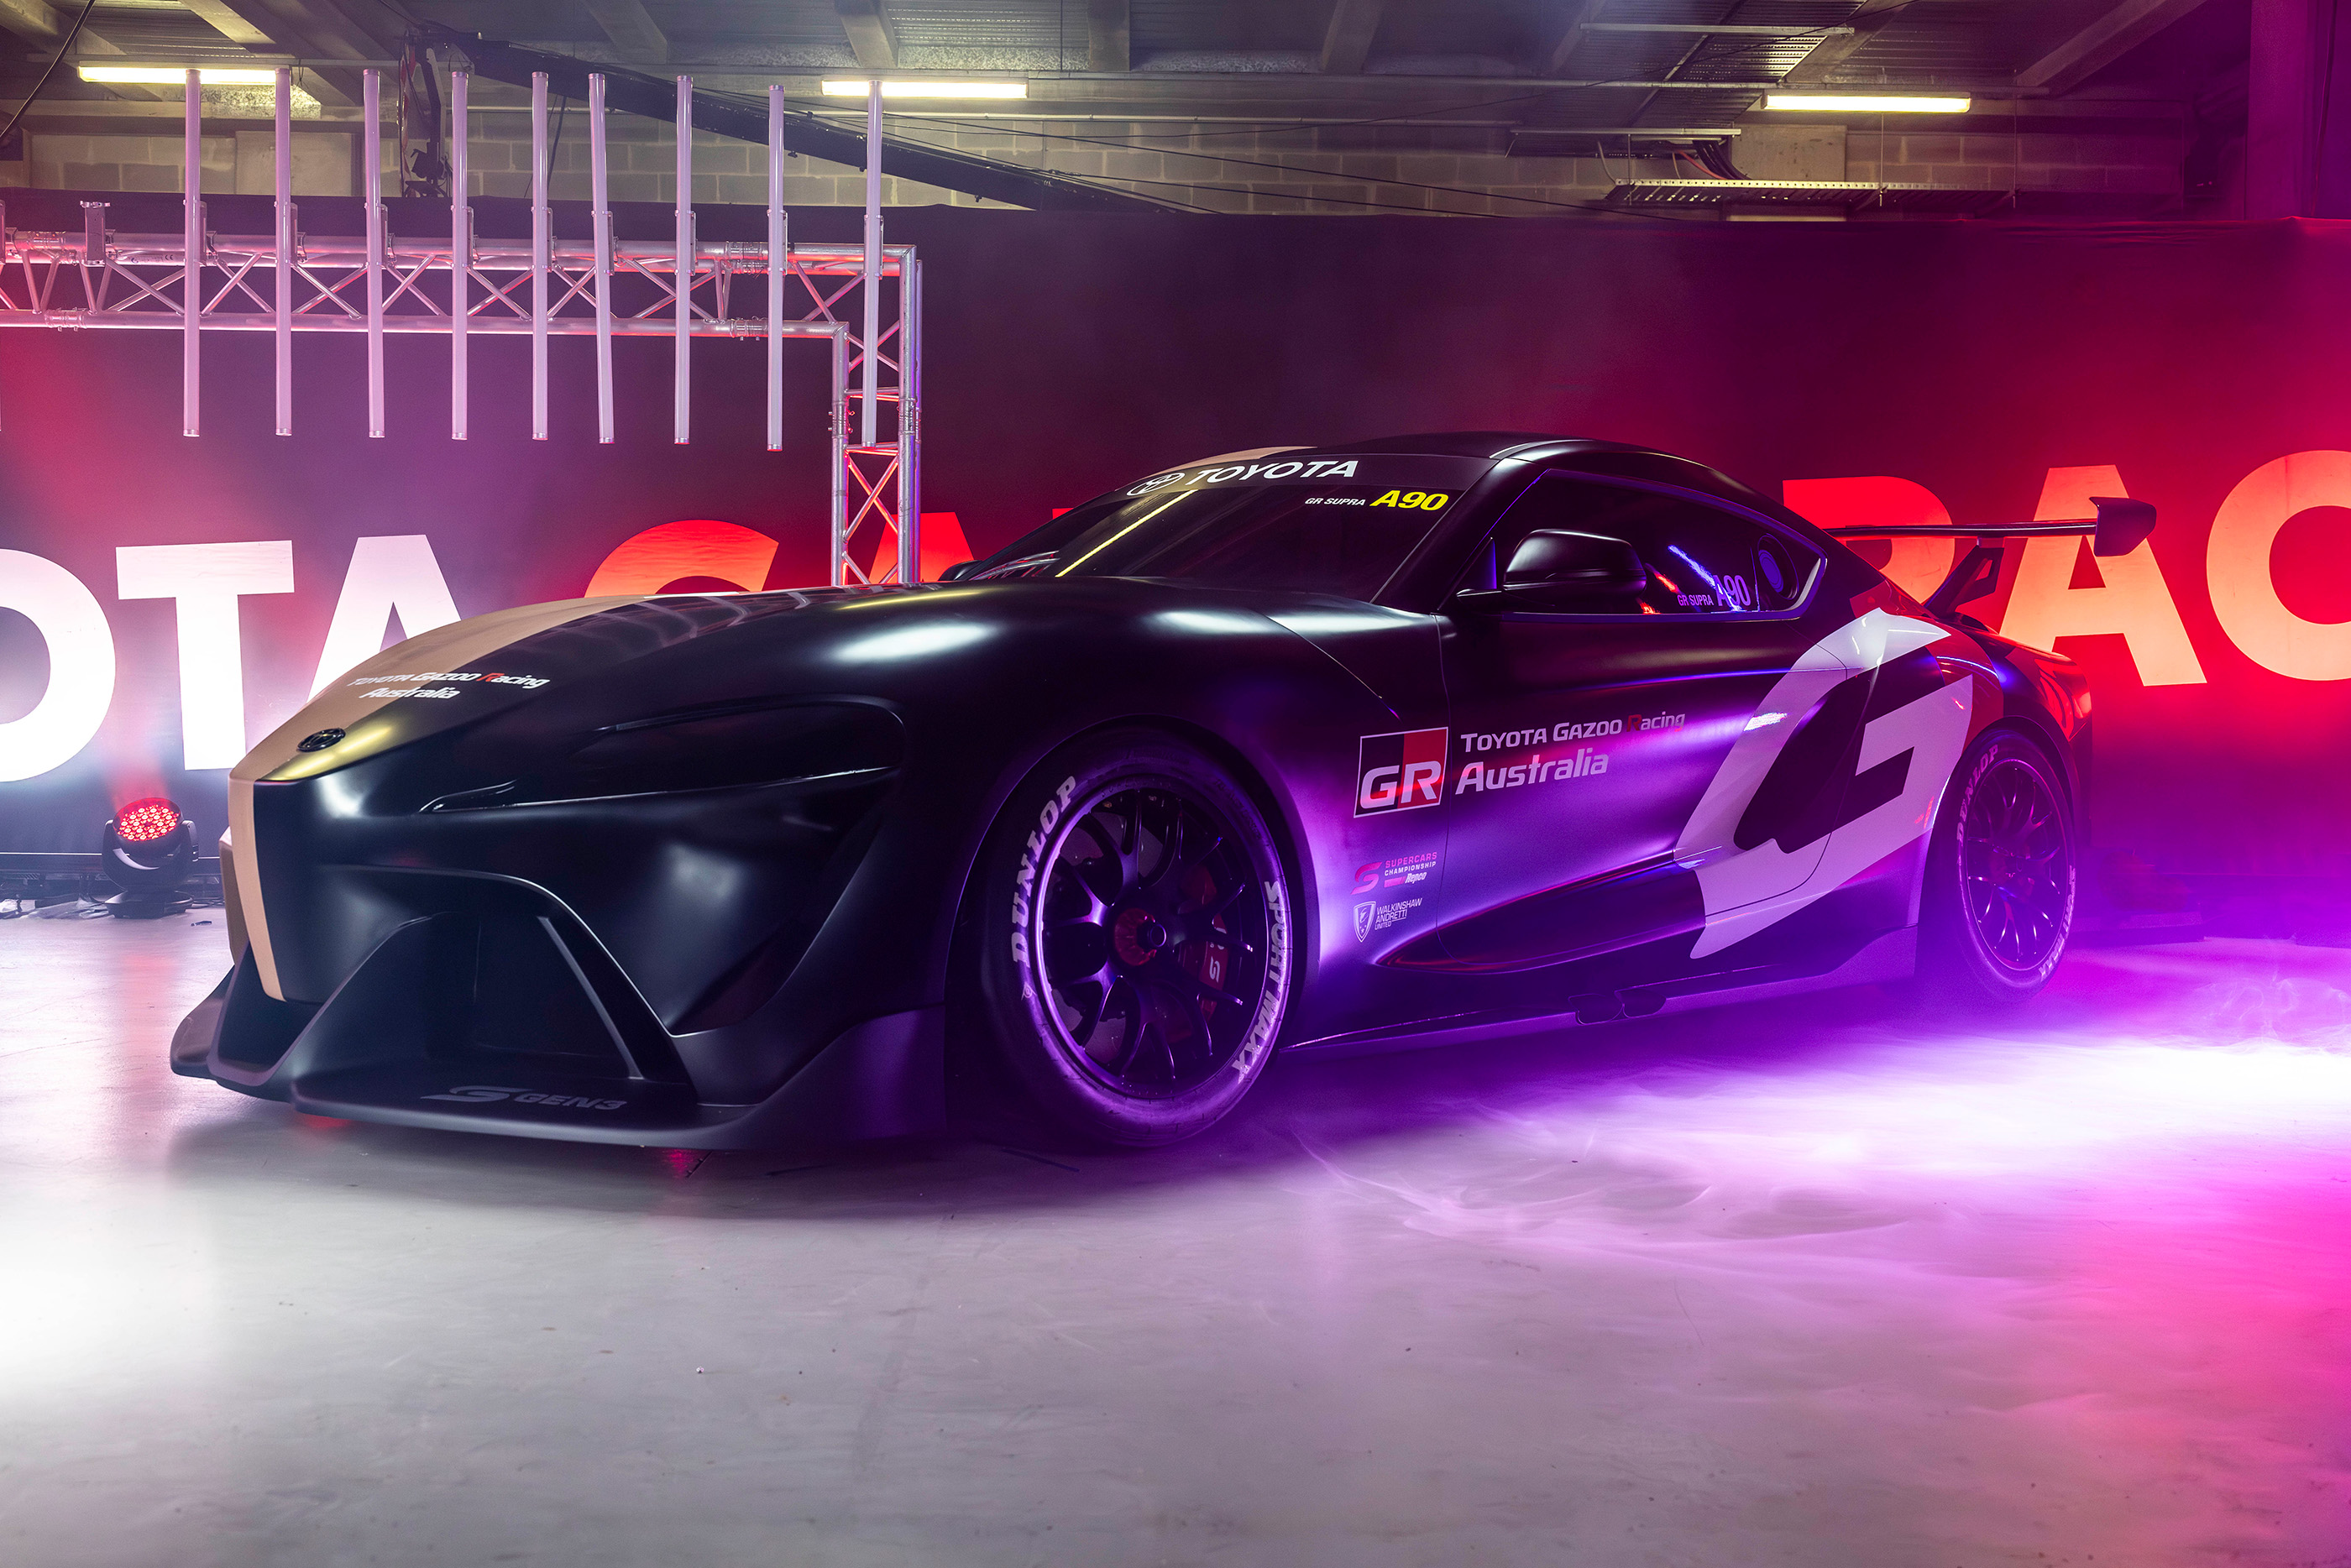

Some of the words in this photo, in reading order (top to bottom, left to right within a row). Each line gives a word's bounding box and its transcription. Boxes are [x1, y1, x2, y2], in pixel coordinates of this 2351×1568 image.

[1186, 460, 1359, 486] TOYOTA
[1324, 498, 1365, 506] SUPRA
[1369, 490, 1449, 511] A90
[1678, 594, 1689, 606] GR
[1689, 594, 1714, 606] SUPRA
[1714, 575, 1751, 607] A90
[347, 674, 414, 686] TOYOTA
[410, 672, 482, 682] GAZOO
[478, 672, 550, 688] Racing
[359, 687, 461, 699] Australia
[1461, 728, 1547, 753] TOYOTA
[1552, 719, 1622, 742] GAZOO
[1626, 712, 1686, 733] Racing
[1455, 749, 1610, 796] Australia
[1360, 760, 1443, 810] GR
[1385, 852, 1437, 868] SUPERCARS
[1385, 861, 1437, 876] CHAMPIONSHIP
[1012, 776, 1076, 970] DUNLOP
[1405, 871, 1427, 884] Repco
[1376, 897, 1422, 915] WALKINSHAW
[1374, 921, 1391, 930] UNITED
[1375, 909, 1407, 924] ANDRETTI
[1265, 880, 1288, 985] SPORT
[1231, 989, 1281, 1084] MAXX
[514, 1094, 627, 1110] GEN3
